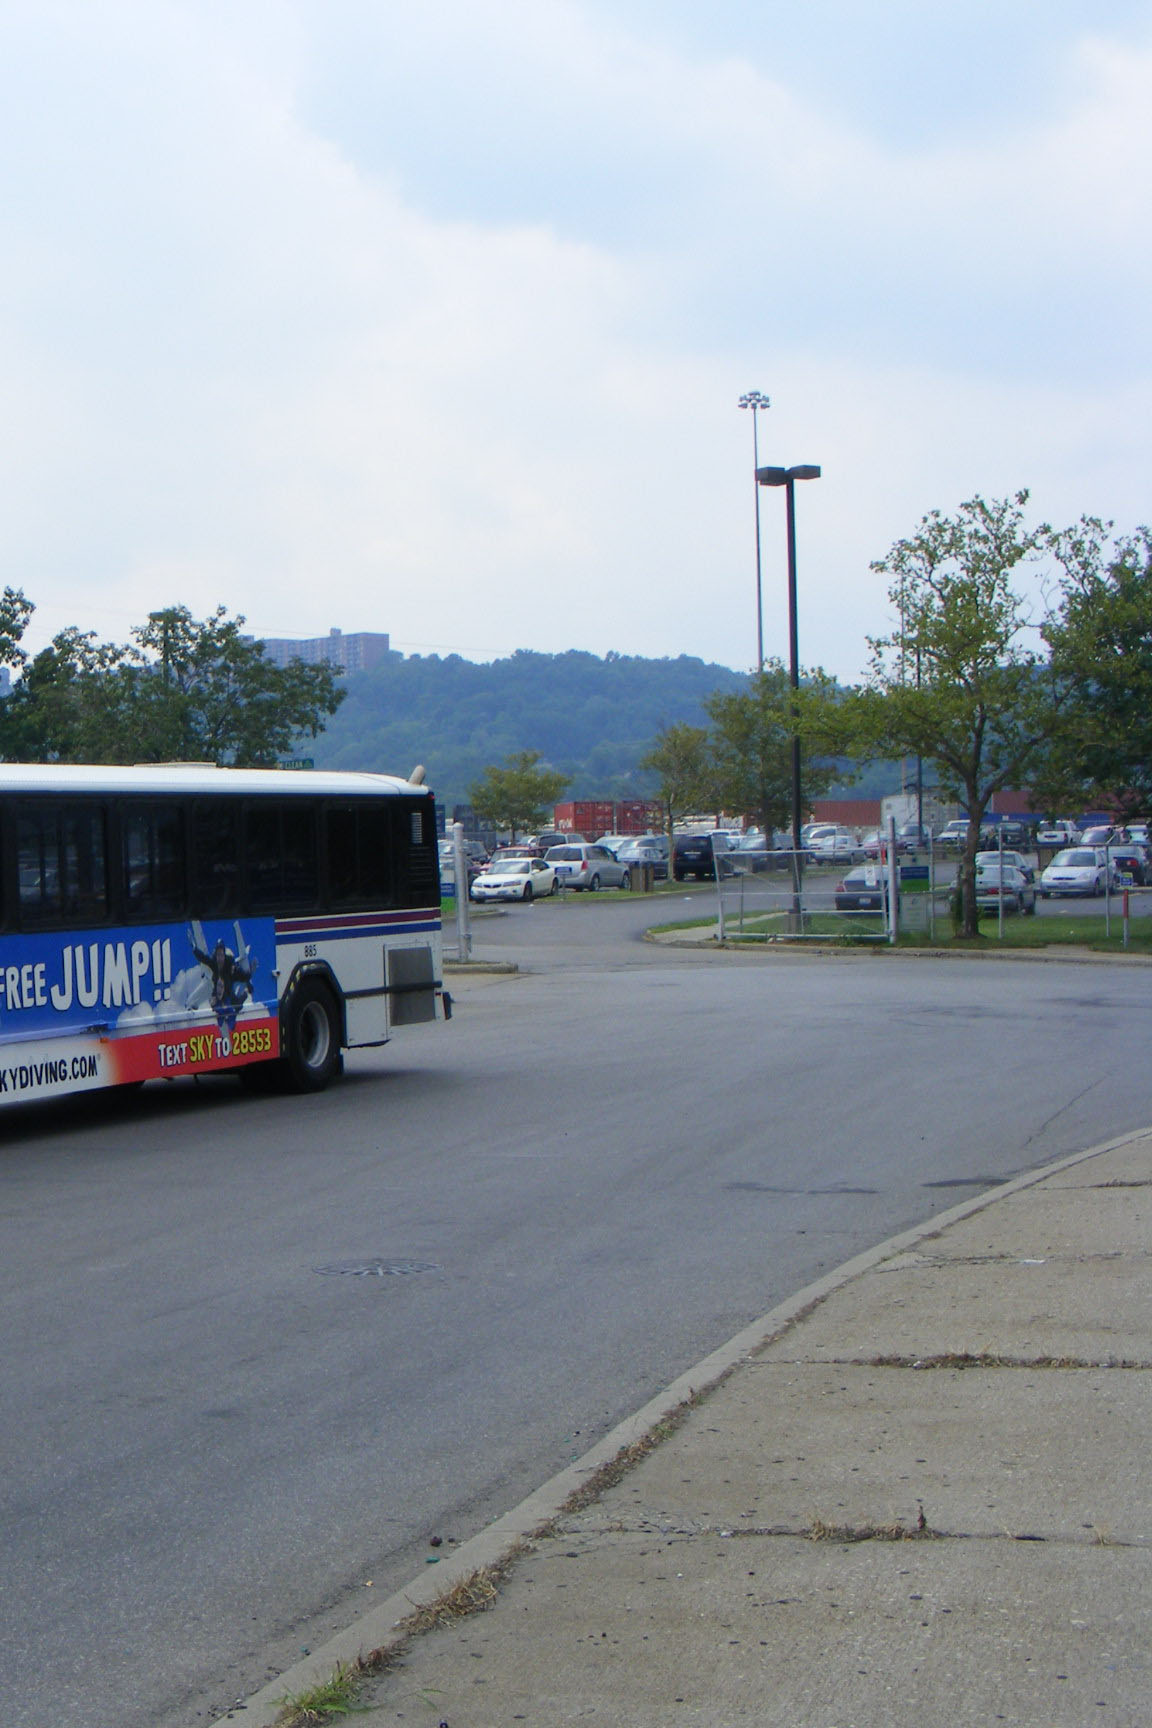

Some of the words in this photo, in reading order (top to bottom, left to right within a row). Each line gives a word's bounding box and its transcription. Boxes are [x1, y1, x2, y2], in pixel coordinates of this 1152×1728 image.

[304, 944, 318, 957] 885
[50, 937, 171, 1012] JUMP!!
[158, 1042, 188, 1067] TEXT
[189, 1034, 214, 1062] SKY
[215, 1037, 231, 1058] TO
[232, 1028, 271, 1056] 28553
